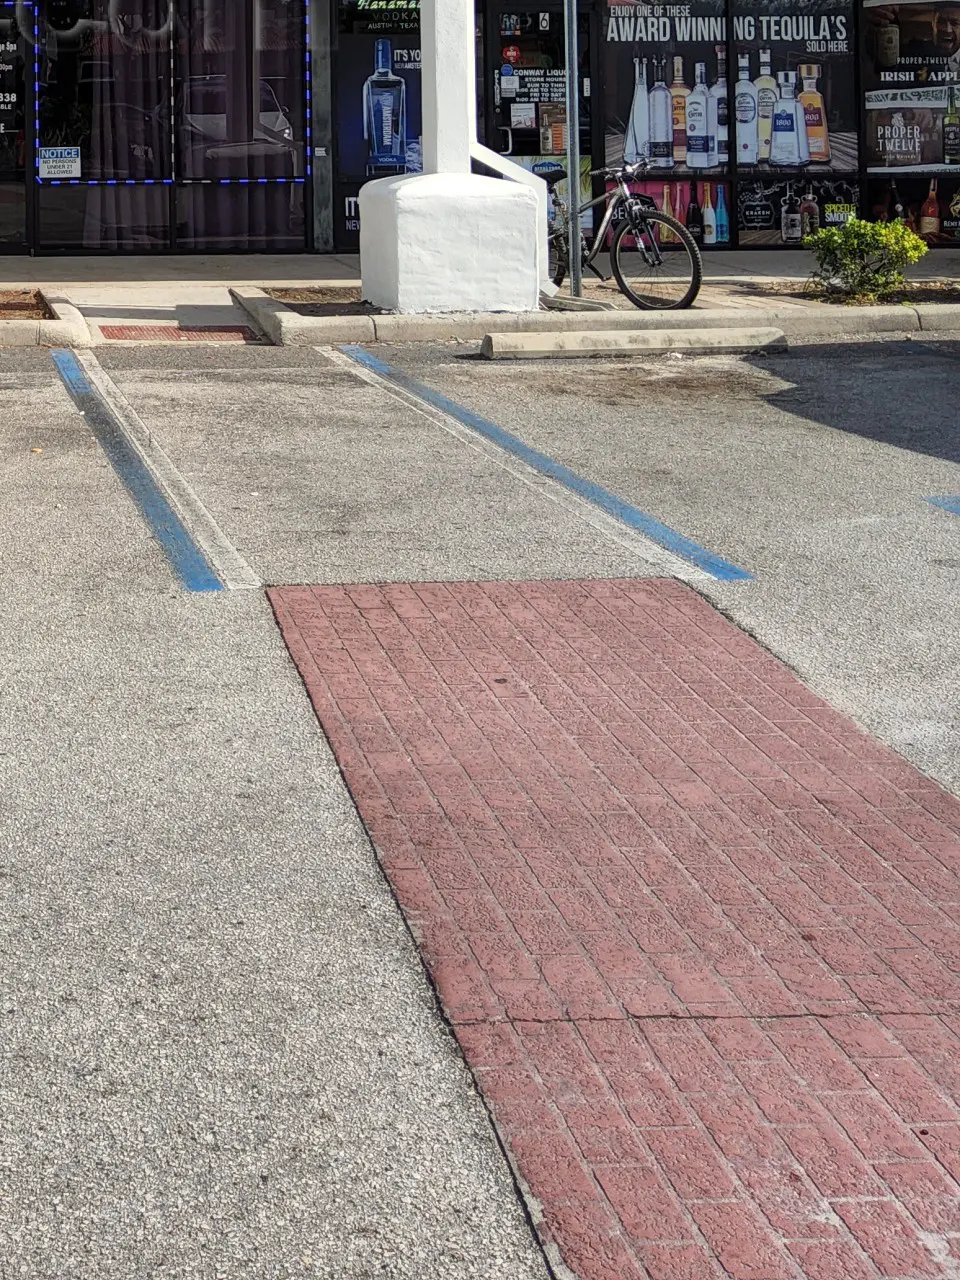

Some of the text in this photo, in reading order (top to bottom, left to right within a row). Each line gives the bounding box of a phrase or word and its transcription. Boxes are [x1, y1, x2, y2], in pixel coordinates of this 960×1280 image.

[372, 11, 419, 21] VODKA
[611, 6, 691, 17] ENJOY ONE OF THESE
[541, 14, 548, 28] 6
[607, 17, 671, 42] AWARD
[759, 16, 847, 41] TEQUILA'S
[6, 42, 17, 52] Spa
[806, 41, 849, 52] SOLD HERE
[394, 49, 422, 62] IT'S YO
[897, 57, 923, 65] PROPER
[880, 72, 915, 81] IRISH
[805, 113, 820, 121] 800
[877, 126, 920, 138] PROPER
[878, 140, 921, 151] TWELVE
[42, 149, 78, 158] NOTICE
[825, 203, 849, 213] SPICED
